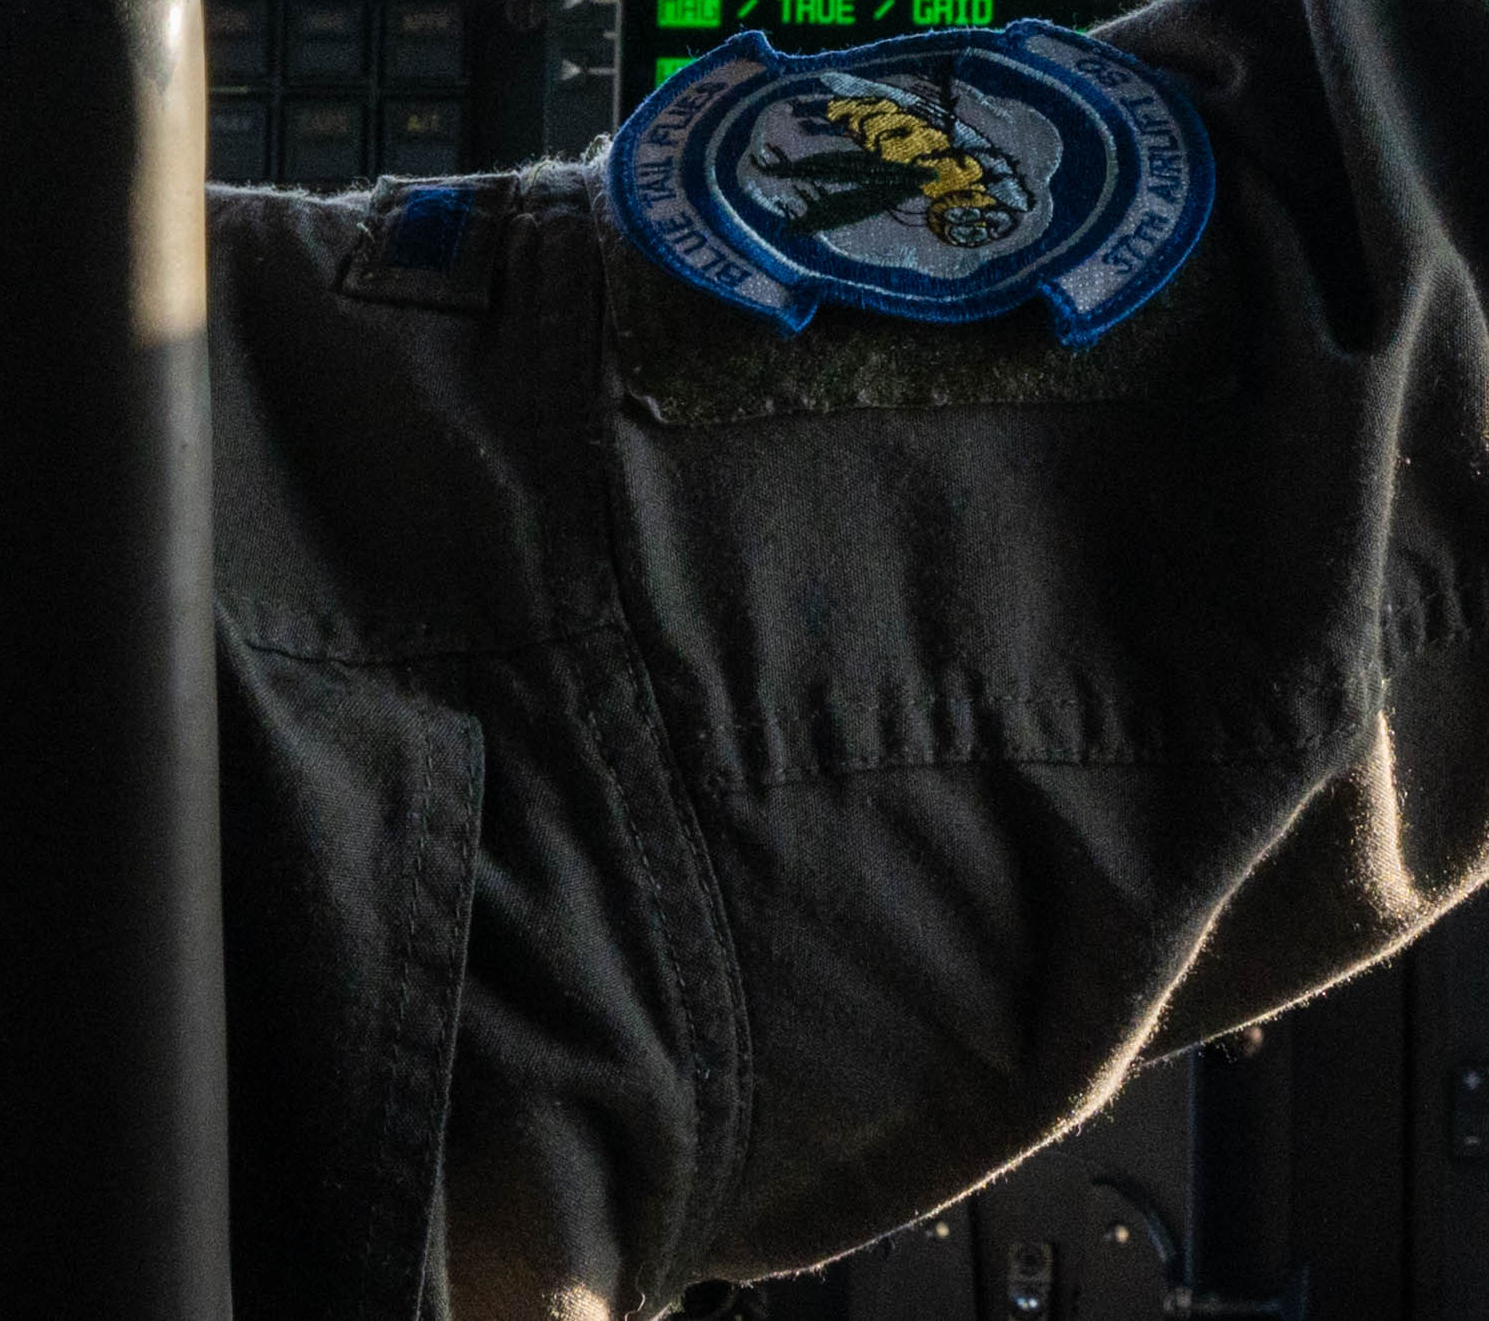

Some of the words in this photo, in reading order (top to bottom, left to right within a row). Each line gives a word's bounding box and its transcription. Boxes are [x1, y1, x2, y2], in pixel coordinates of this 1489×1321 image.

[639, 156, 676, 208] TAIL
[1119, 95, 1183, 203] AIRLIFT
[657, 211, 752, 288] BLUE
